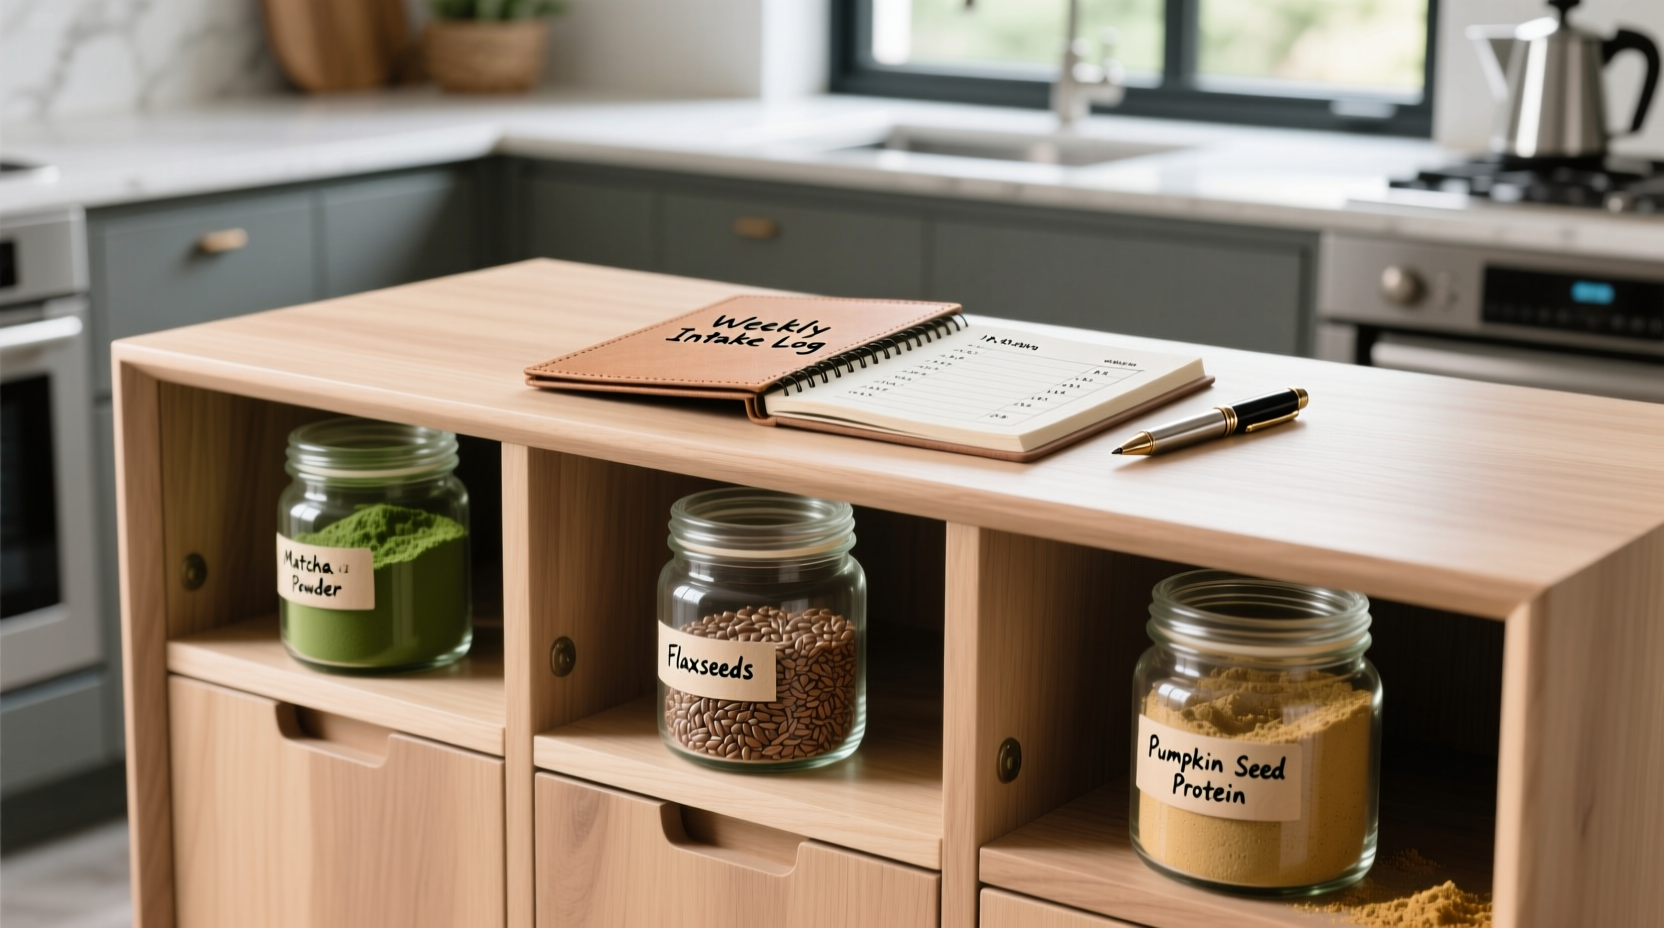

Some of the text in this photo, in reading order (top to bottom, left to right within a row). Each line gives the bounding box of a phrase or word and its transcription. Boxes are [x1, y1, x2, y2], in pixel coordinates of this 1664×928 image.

[712, 314, 832, 339] Weekly
[665, 327, 827, 355] Intake Log
[283, 549, 334, 575] Matcha
[292, 574, 342, 598] Powder
[668, 643, 754, 680] Flaxseeds
[1148, 734, 1287, 780] Pumpkin Seed
[1172, 772, 1246, 805] Protein
